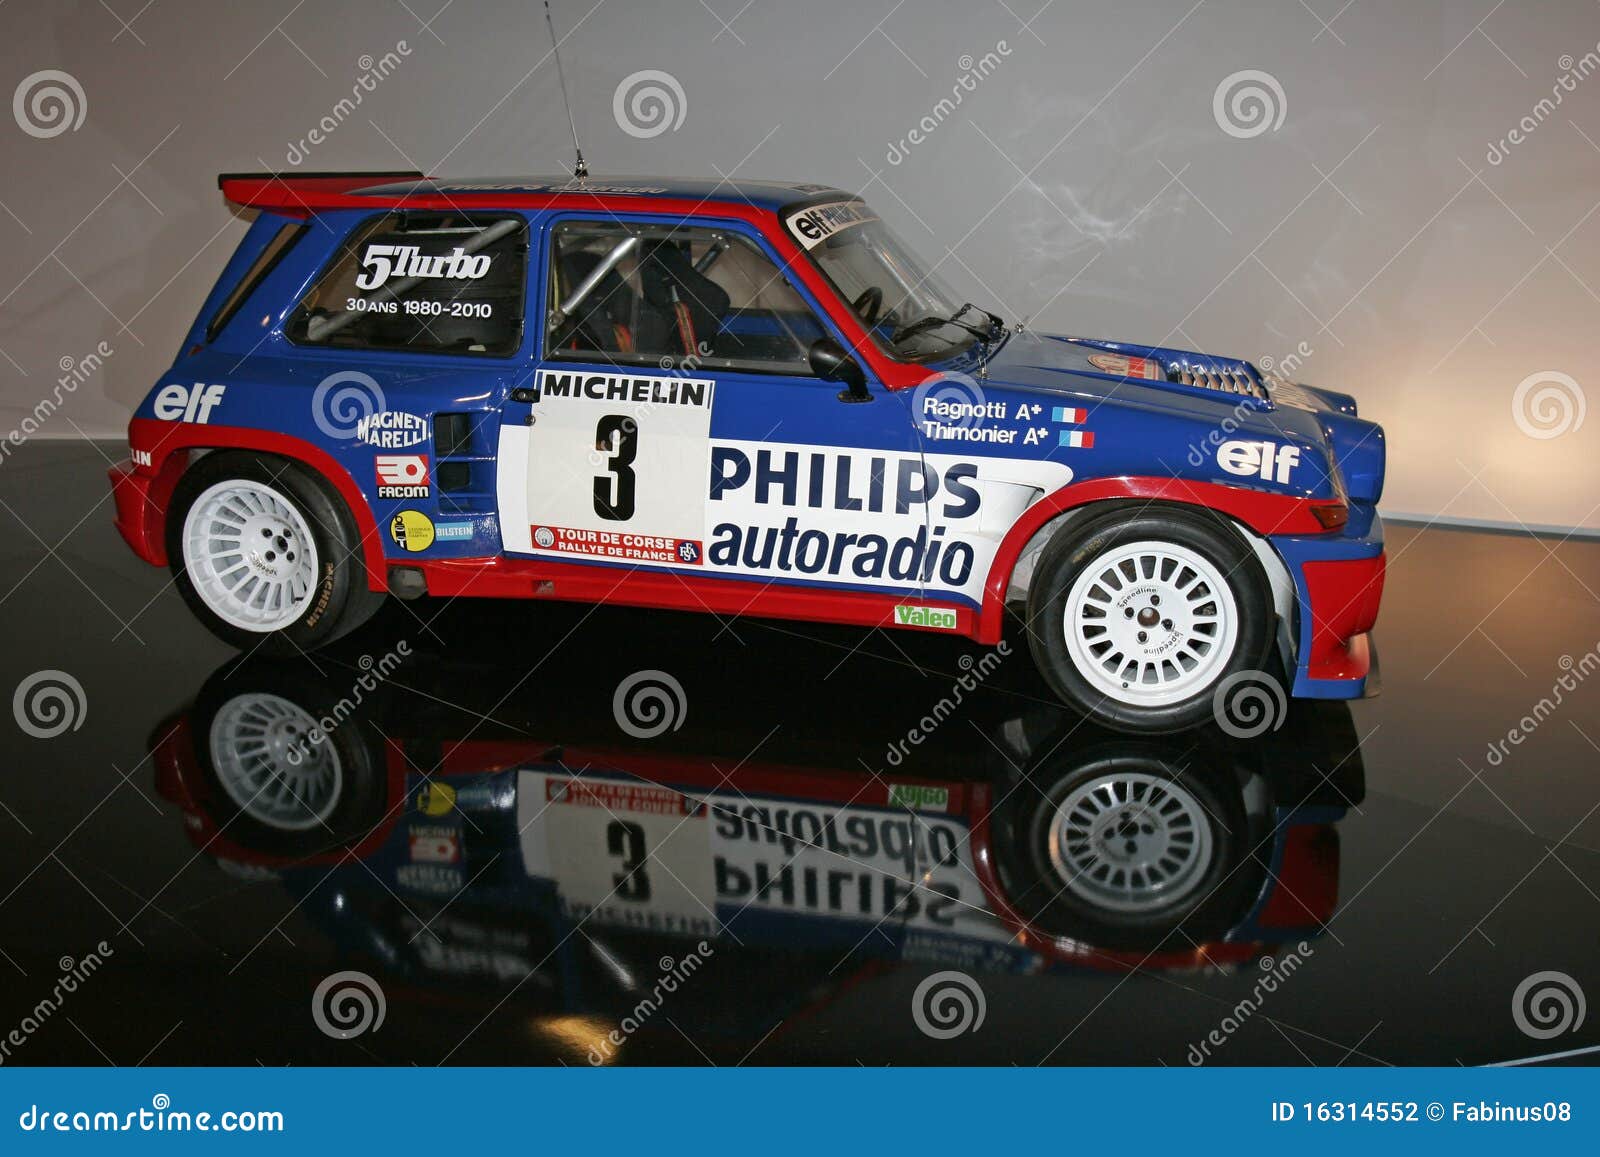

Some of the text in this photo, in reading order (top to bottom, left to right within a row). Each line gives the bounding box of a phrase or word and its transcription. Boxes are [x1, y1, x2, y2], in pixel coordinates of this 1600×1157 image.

[795, 210, 833, 240] elf
[403, 300, 492, 318] 1980-2010
[544, 374, 705, 406] MICHELIN
[154, 383, 226, 424] elf
[923, 397, 1007, 420] Ragnotti
[358, 412, 428, 433] MAGNETI
[922, 421, 1018, 444] Thimonier
[358, 426, 429, 448] MARELLI
[593, 414, 638, 521] 3
[1217, 440, 1299, 484] elf
[378, 486, 429, 498] FACOM
[709, 446, 981, 519] PHILIPS
[557, 528, 675, 550] TOUR DE CORSE
[558, 541, 676, 562] RALLYE DE FRANCE
[708, 517, 974, 586] autoradio
[1117, 587, 1157, 608] Speedline
[896, 606, 955, 627] Valeo
